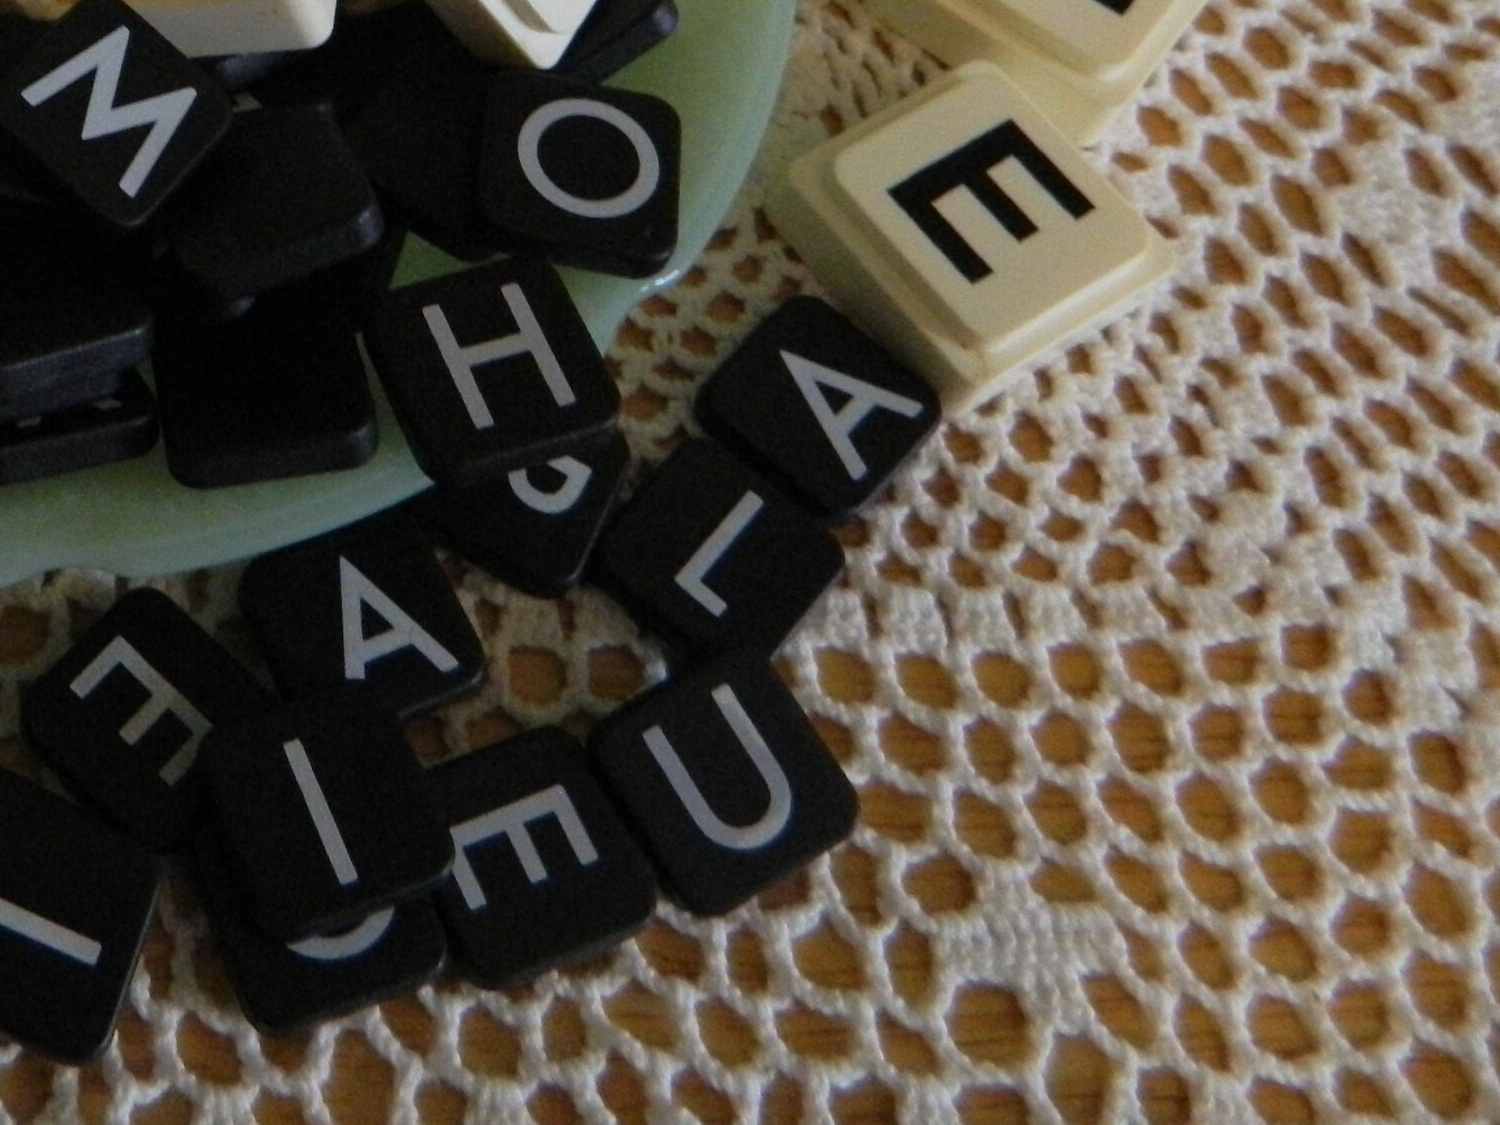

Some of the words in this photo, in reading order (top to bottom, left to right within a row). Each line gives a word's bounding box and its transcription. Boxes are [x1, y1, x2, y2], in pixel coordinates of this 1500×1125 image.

[515, 95, 662, 220] O
[885, 118, 1096, 286] E
[420, 280, 579, 432] H
[778, 348, 925, 482] A
[337, 554, 462, 681] A
[673, 488, 766, 619] L
[67, 633, 216, 787] E
[641, 683, 794, 852] U
[446, 783, 600, 912] E
